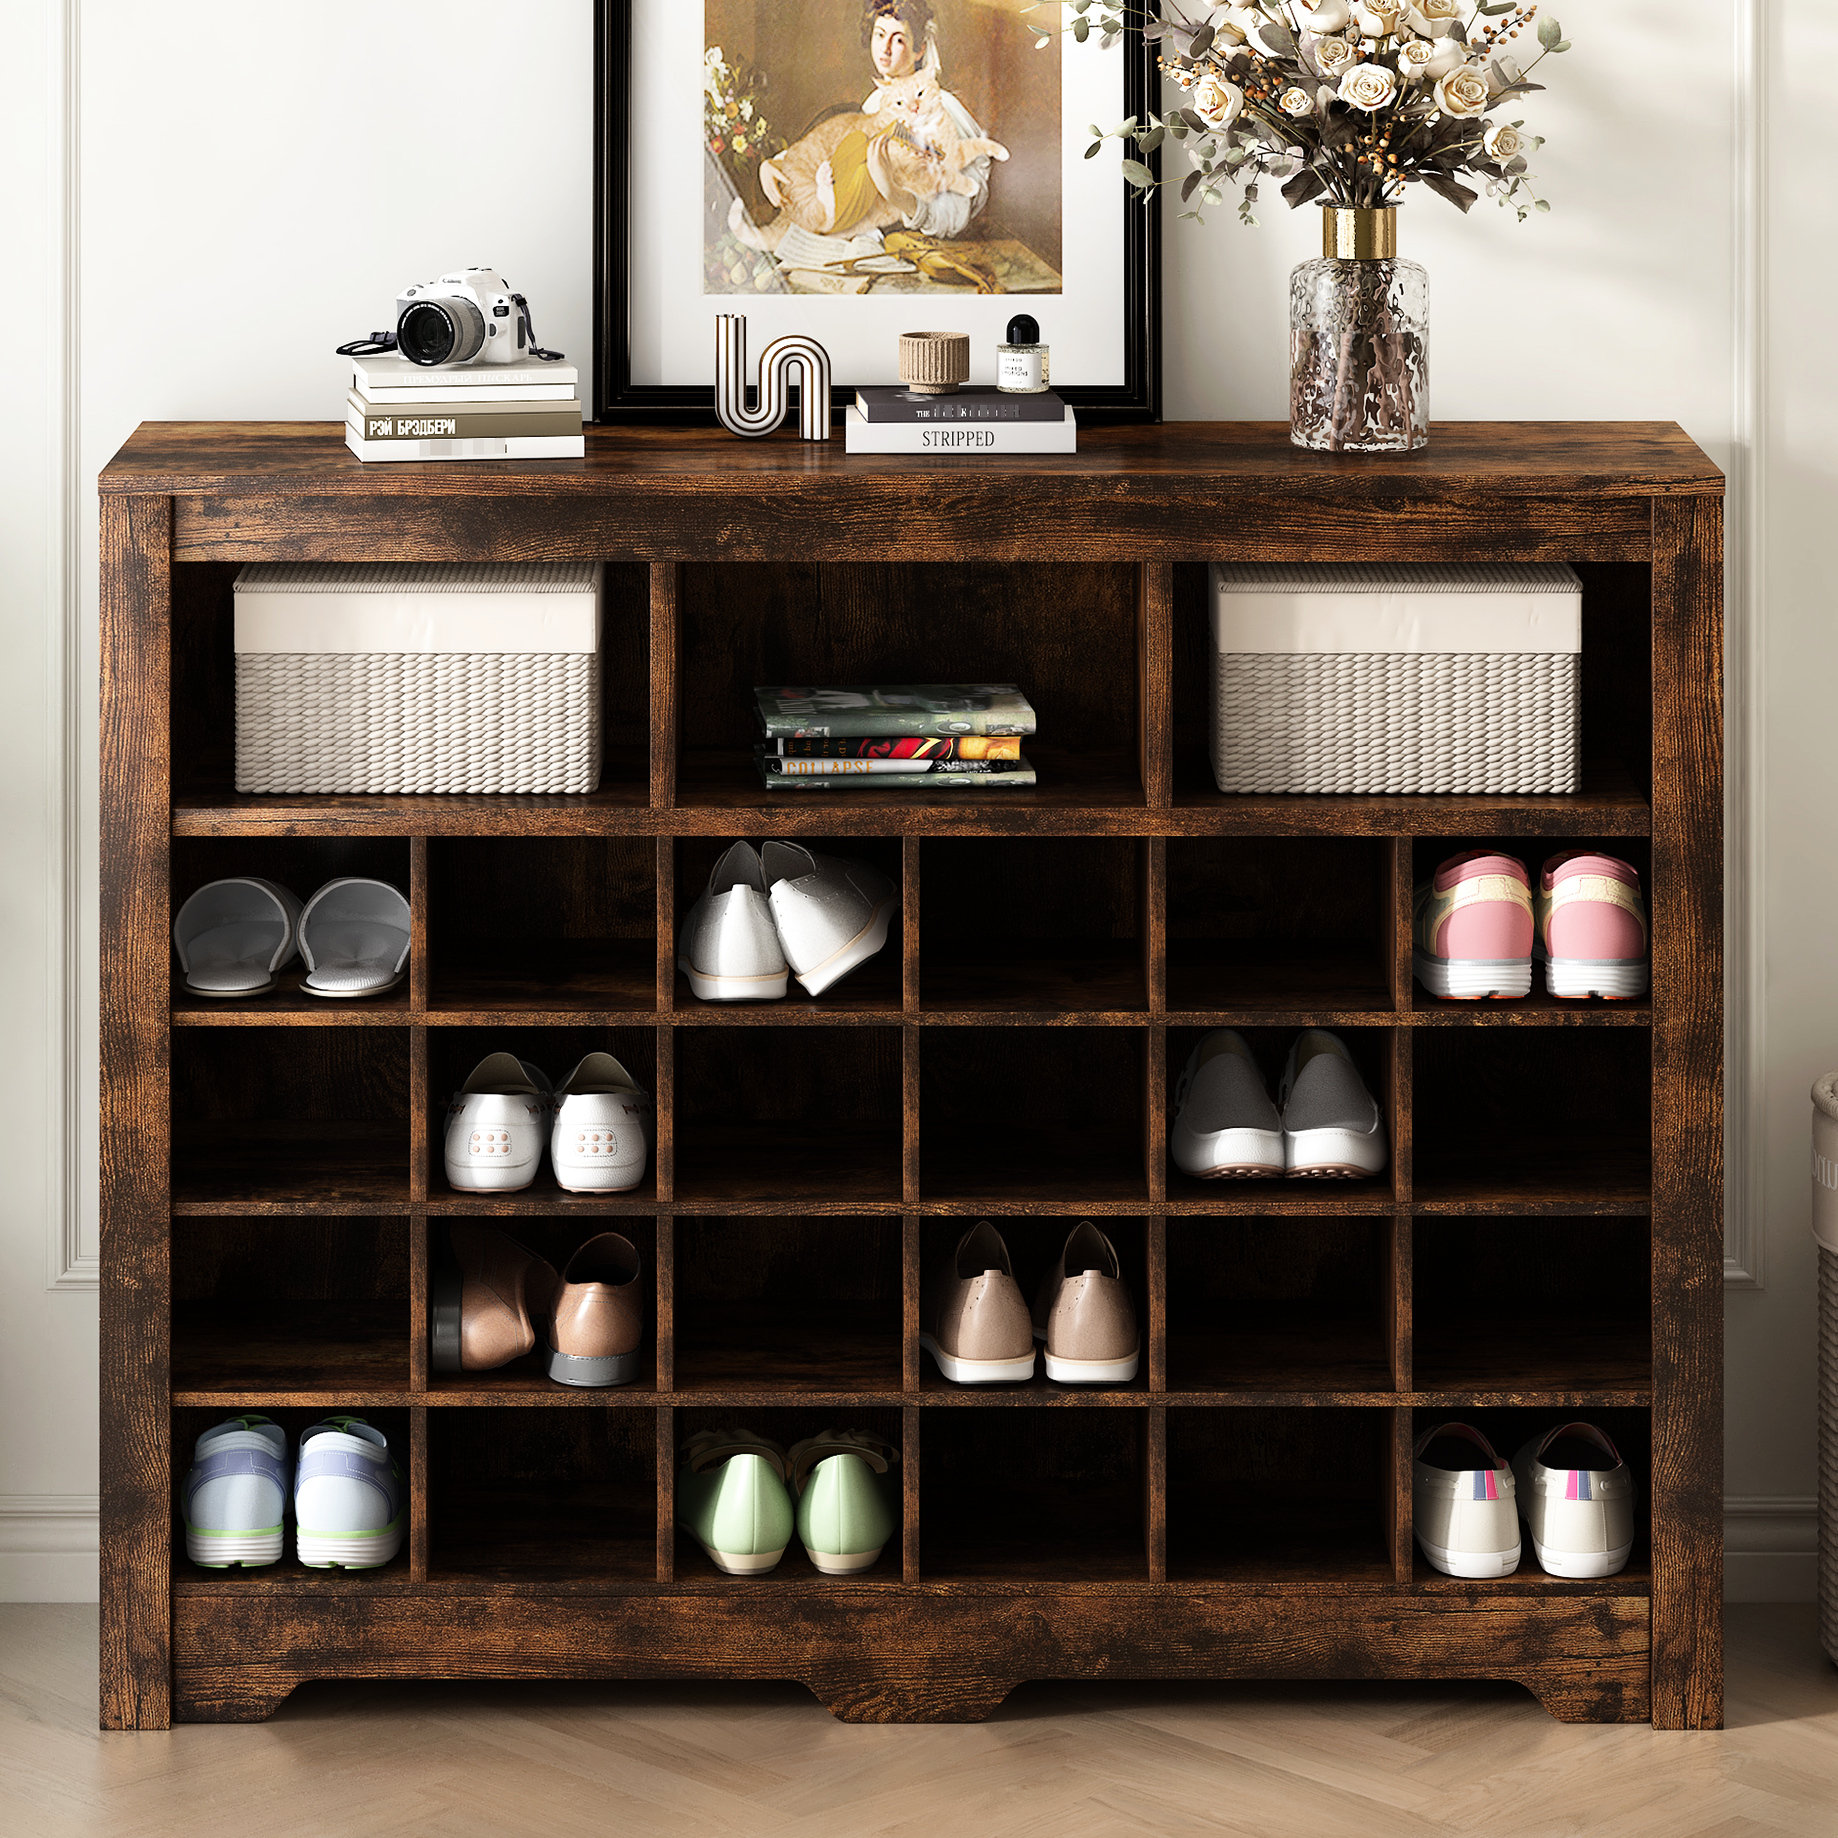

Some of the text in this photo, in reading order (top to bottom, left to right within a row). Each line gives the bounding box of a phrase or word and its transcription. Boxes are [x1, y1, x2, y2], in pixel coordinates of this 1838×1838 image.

[368, 416, 456, 436] РЭЙ БРЭДБЕРИ
[922, 430, 995, 447] STRIPPED
[786, 759, 874, 774] COLLAPSE
